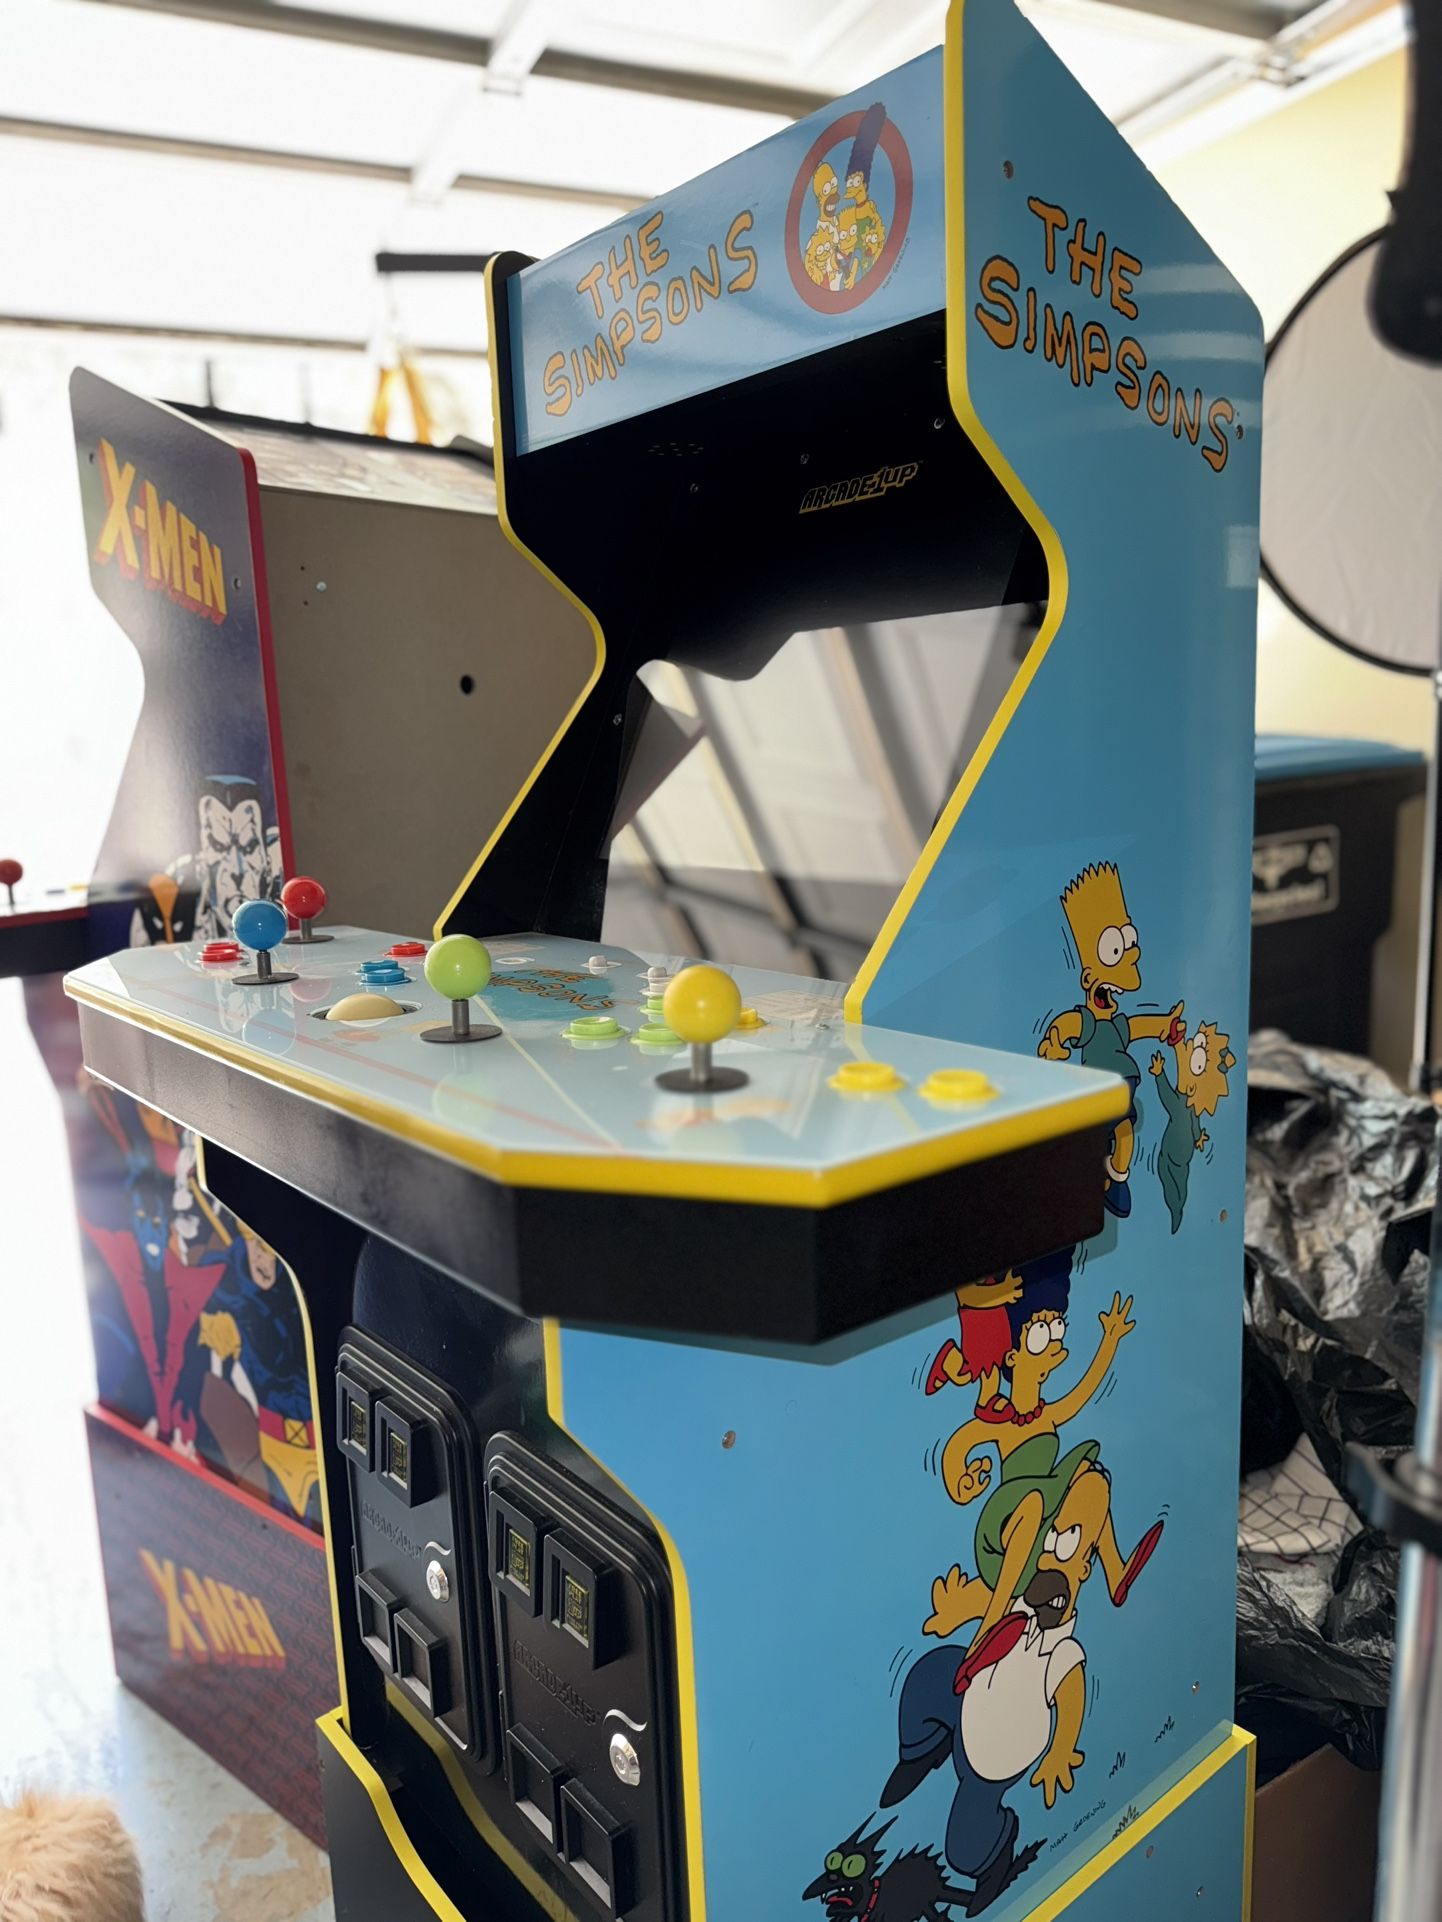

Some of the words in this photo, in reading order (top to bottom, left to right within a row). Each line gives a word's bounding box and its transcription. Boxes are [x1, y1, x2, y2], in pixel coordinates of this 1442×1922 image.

[542, 208, 759, 417] SIMPSONS
[577, 210, 670, 319] THE
[1027, 195, 1142, 320] THE
[975, 255, 1234, 473] SIMPSONS
[93, 437, 228, 626] X-MEN
[138, 1547, 286, 1672] X-MEN
